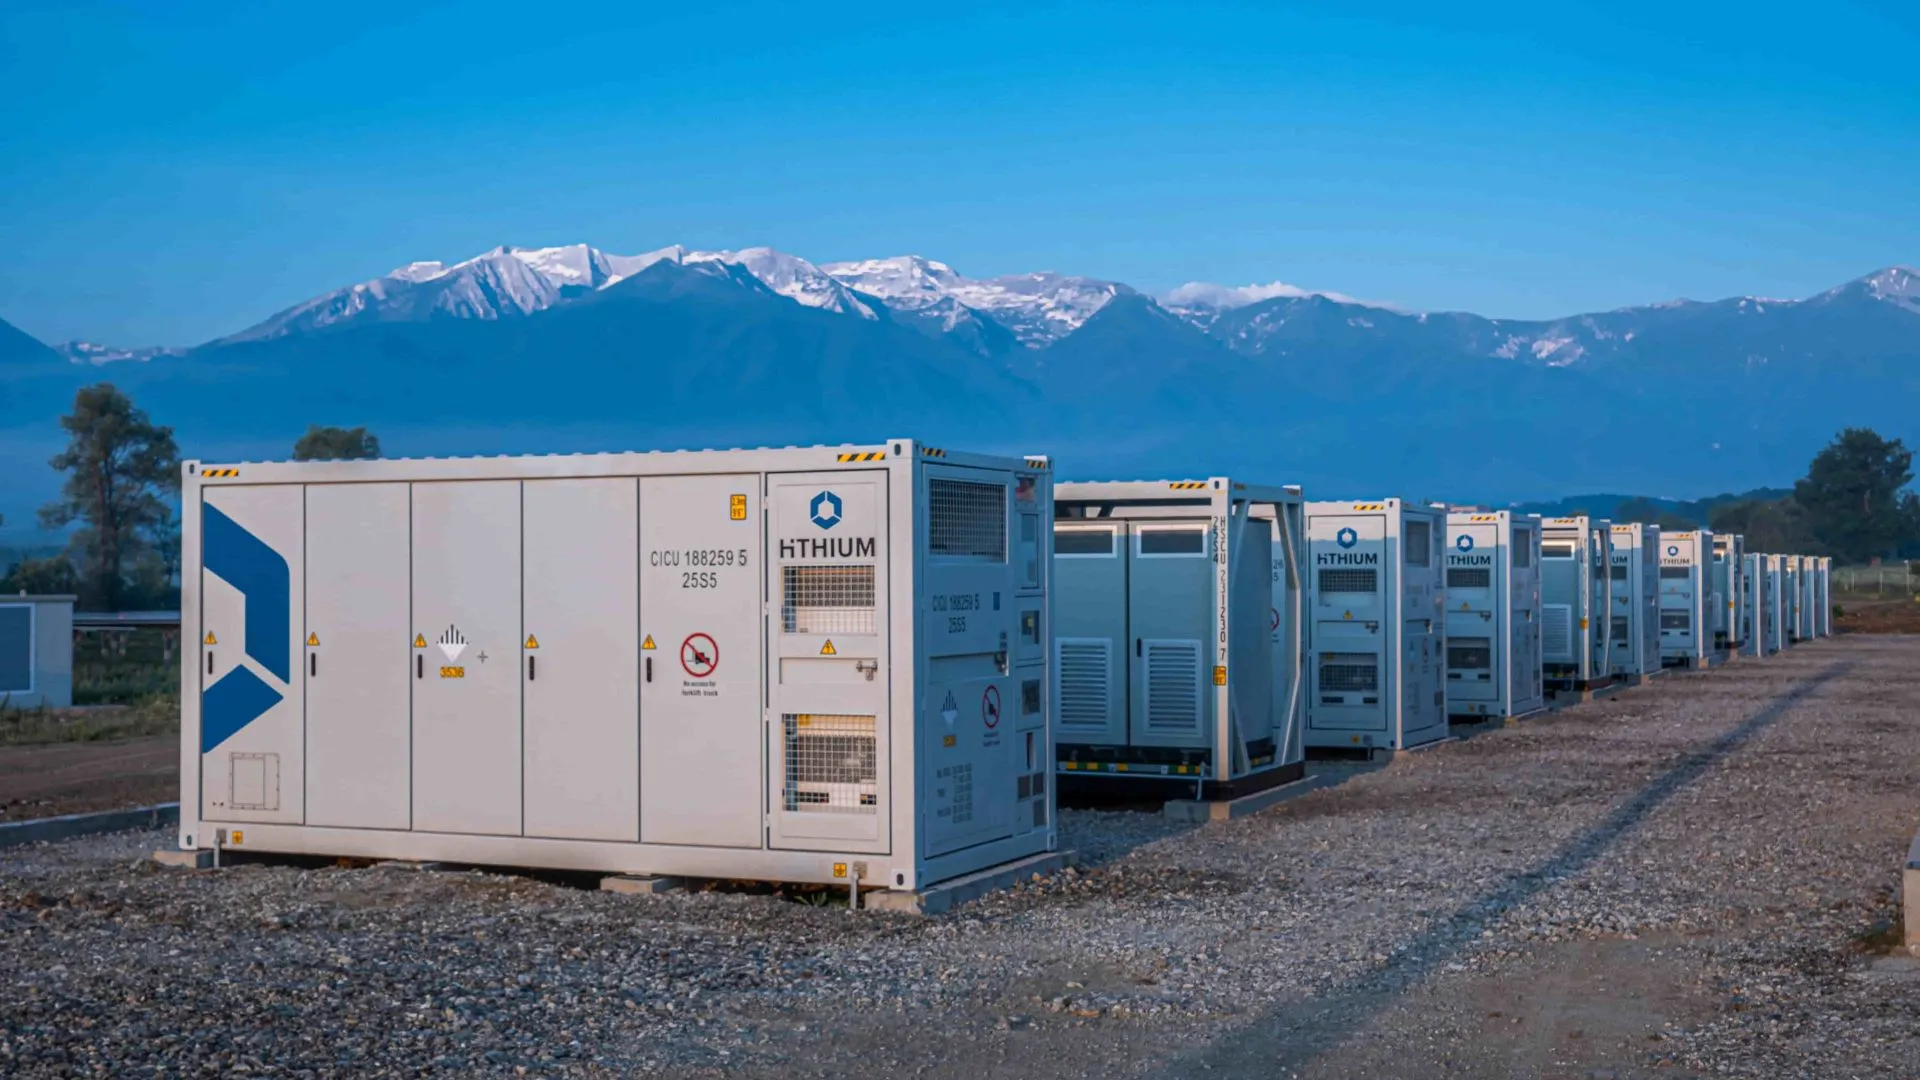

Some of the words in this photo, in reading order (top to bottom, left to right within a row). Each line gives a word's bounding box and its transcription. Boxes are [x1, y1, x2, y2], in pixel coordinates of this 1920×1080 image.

[650, 550, 680, 567] CICU
[684, 549, 734, 567] 188259
[738, 548, 748, 567] 5
[682, 571, 718, 589] 25S5
[1219, 647, 1226, 661] 7
